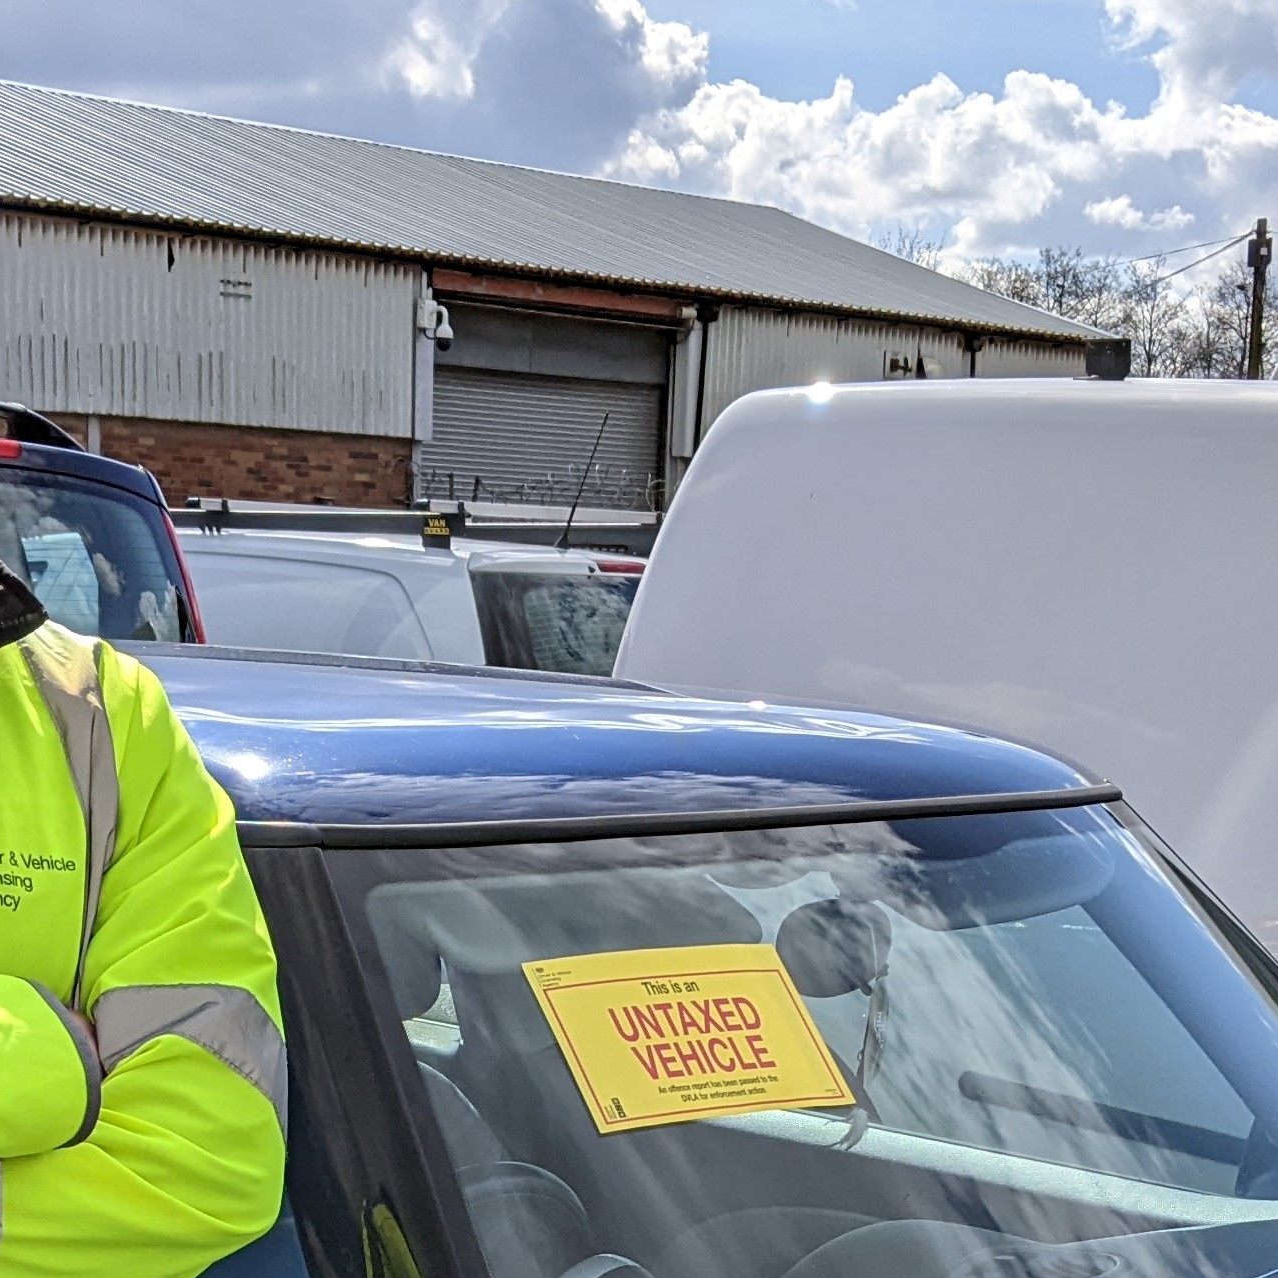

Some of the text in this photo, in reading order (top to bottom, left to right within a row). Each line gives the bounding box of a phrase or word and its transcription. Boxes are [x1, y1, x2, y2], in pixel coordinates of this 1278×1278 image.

[428, 518, 446, 527] VAN
[9, 851, 19, 867] &
[21, 853, 76, 871] Vehicle
[641, 980, 700, 996] This is an
[608, 997, 761, 1042] UNTAXED
[631, 1034, 777, 1080] VEHICLE
[691, 1081, 710, 1090] report
